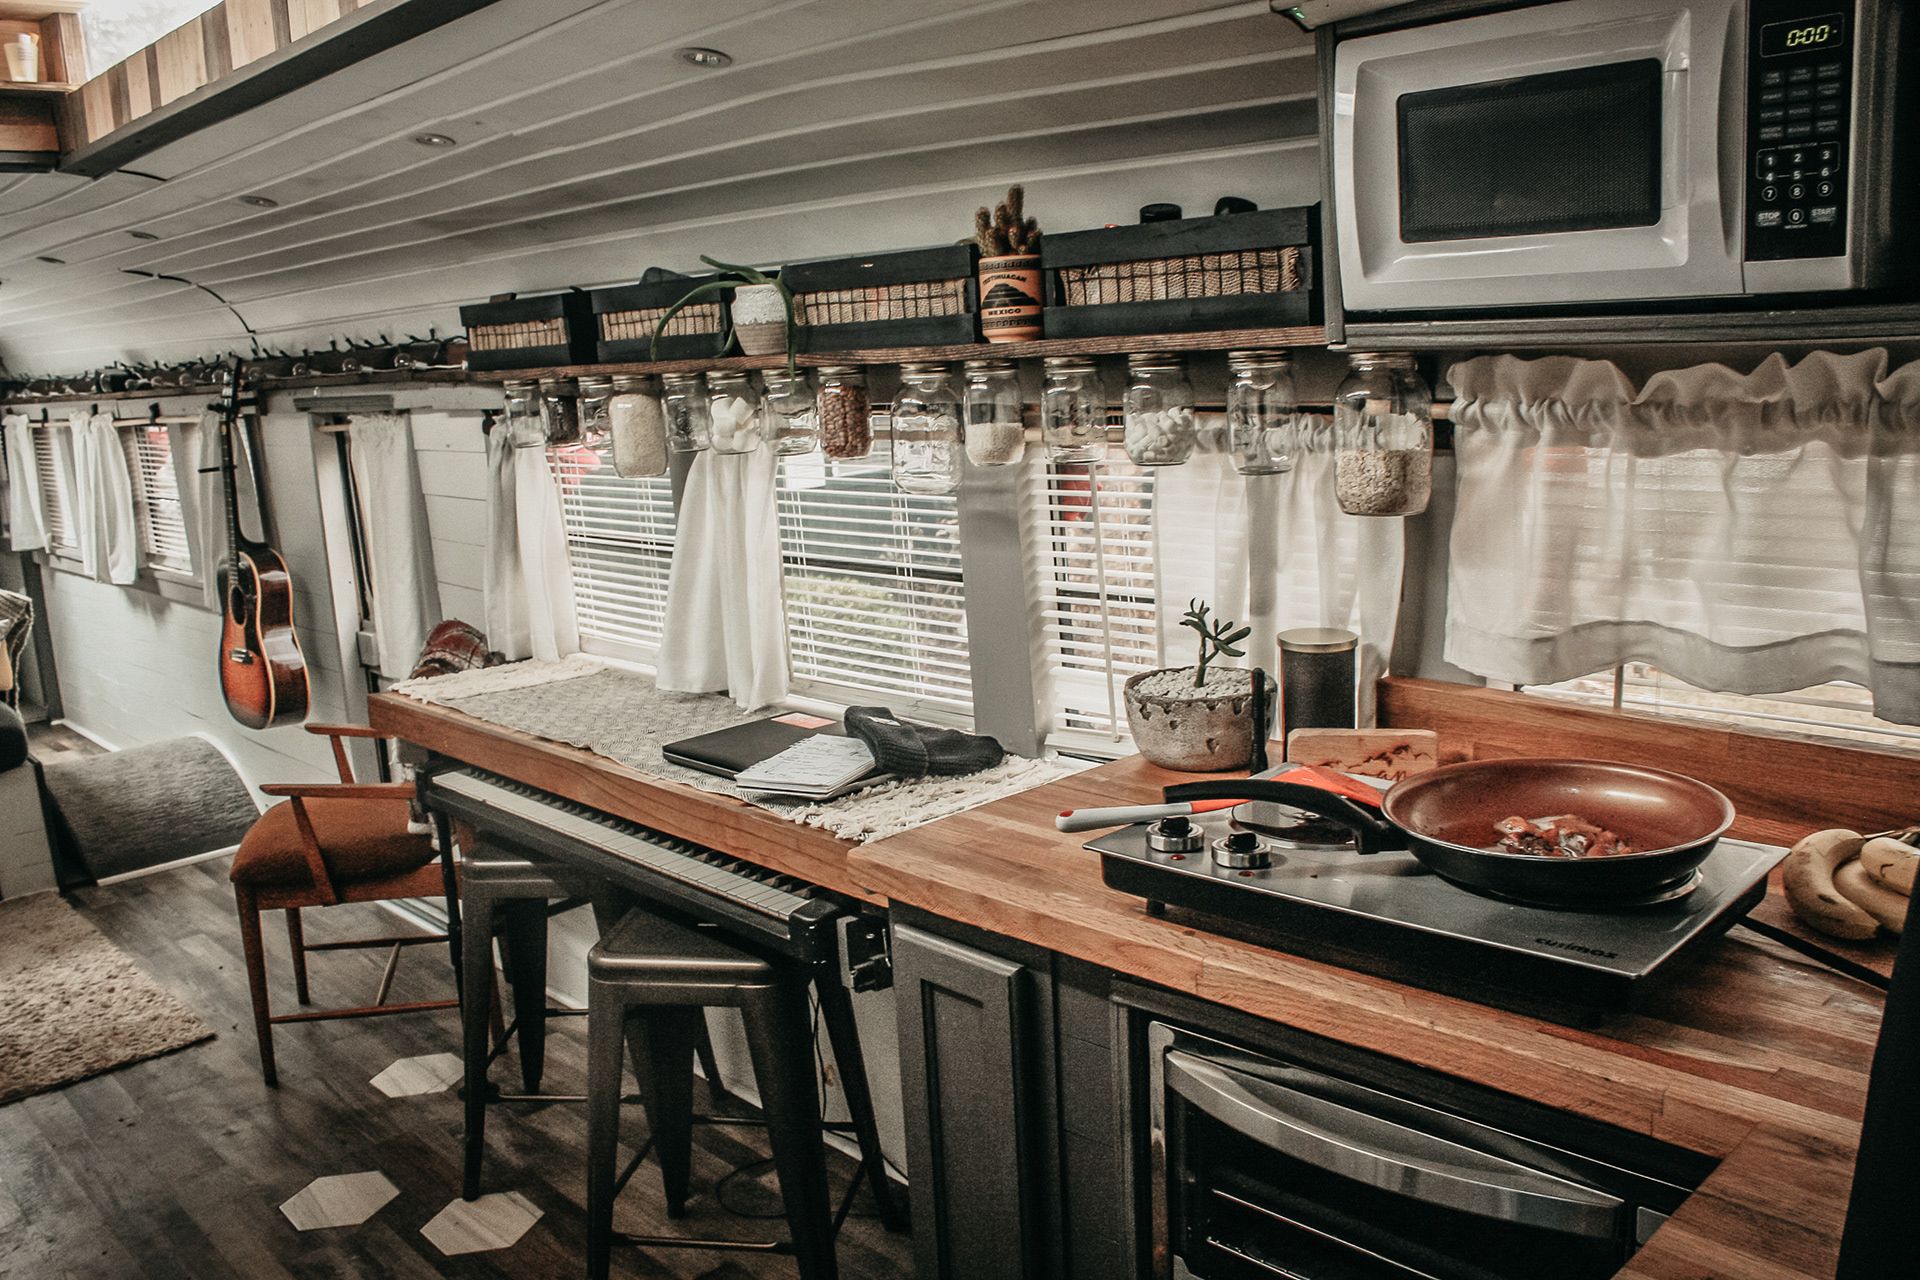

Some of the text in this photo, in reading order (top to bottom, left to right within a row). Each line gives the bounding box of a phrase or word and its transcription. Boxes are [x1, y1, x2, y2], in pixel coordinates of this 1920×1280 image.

[1786, 24, 1830, 46] 0:00
[1767, 150, 1830, 166] 1 2 3
[1765, 167, 1829, 181] 4 5 6
[1767, 184, 1829, 198] 7 8 9
[1758, 207, 1836, 221] STOP 0 START
[988, 308, 1022, 316] MEXICO
